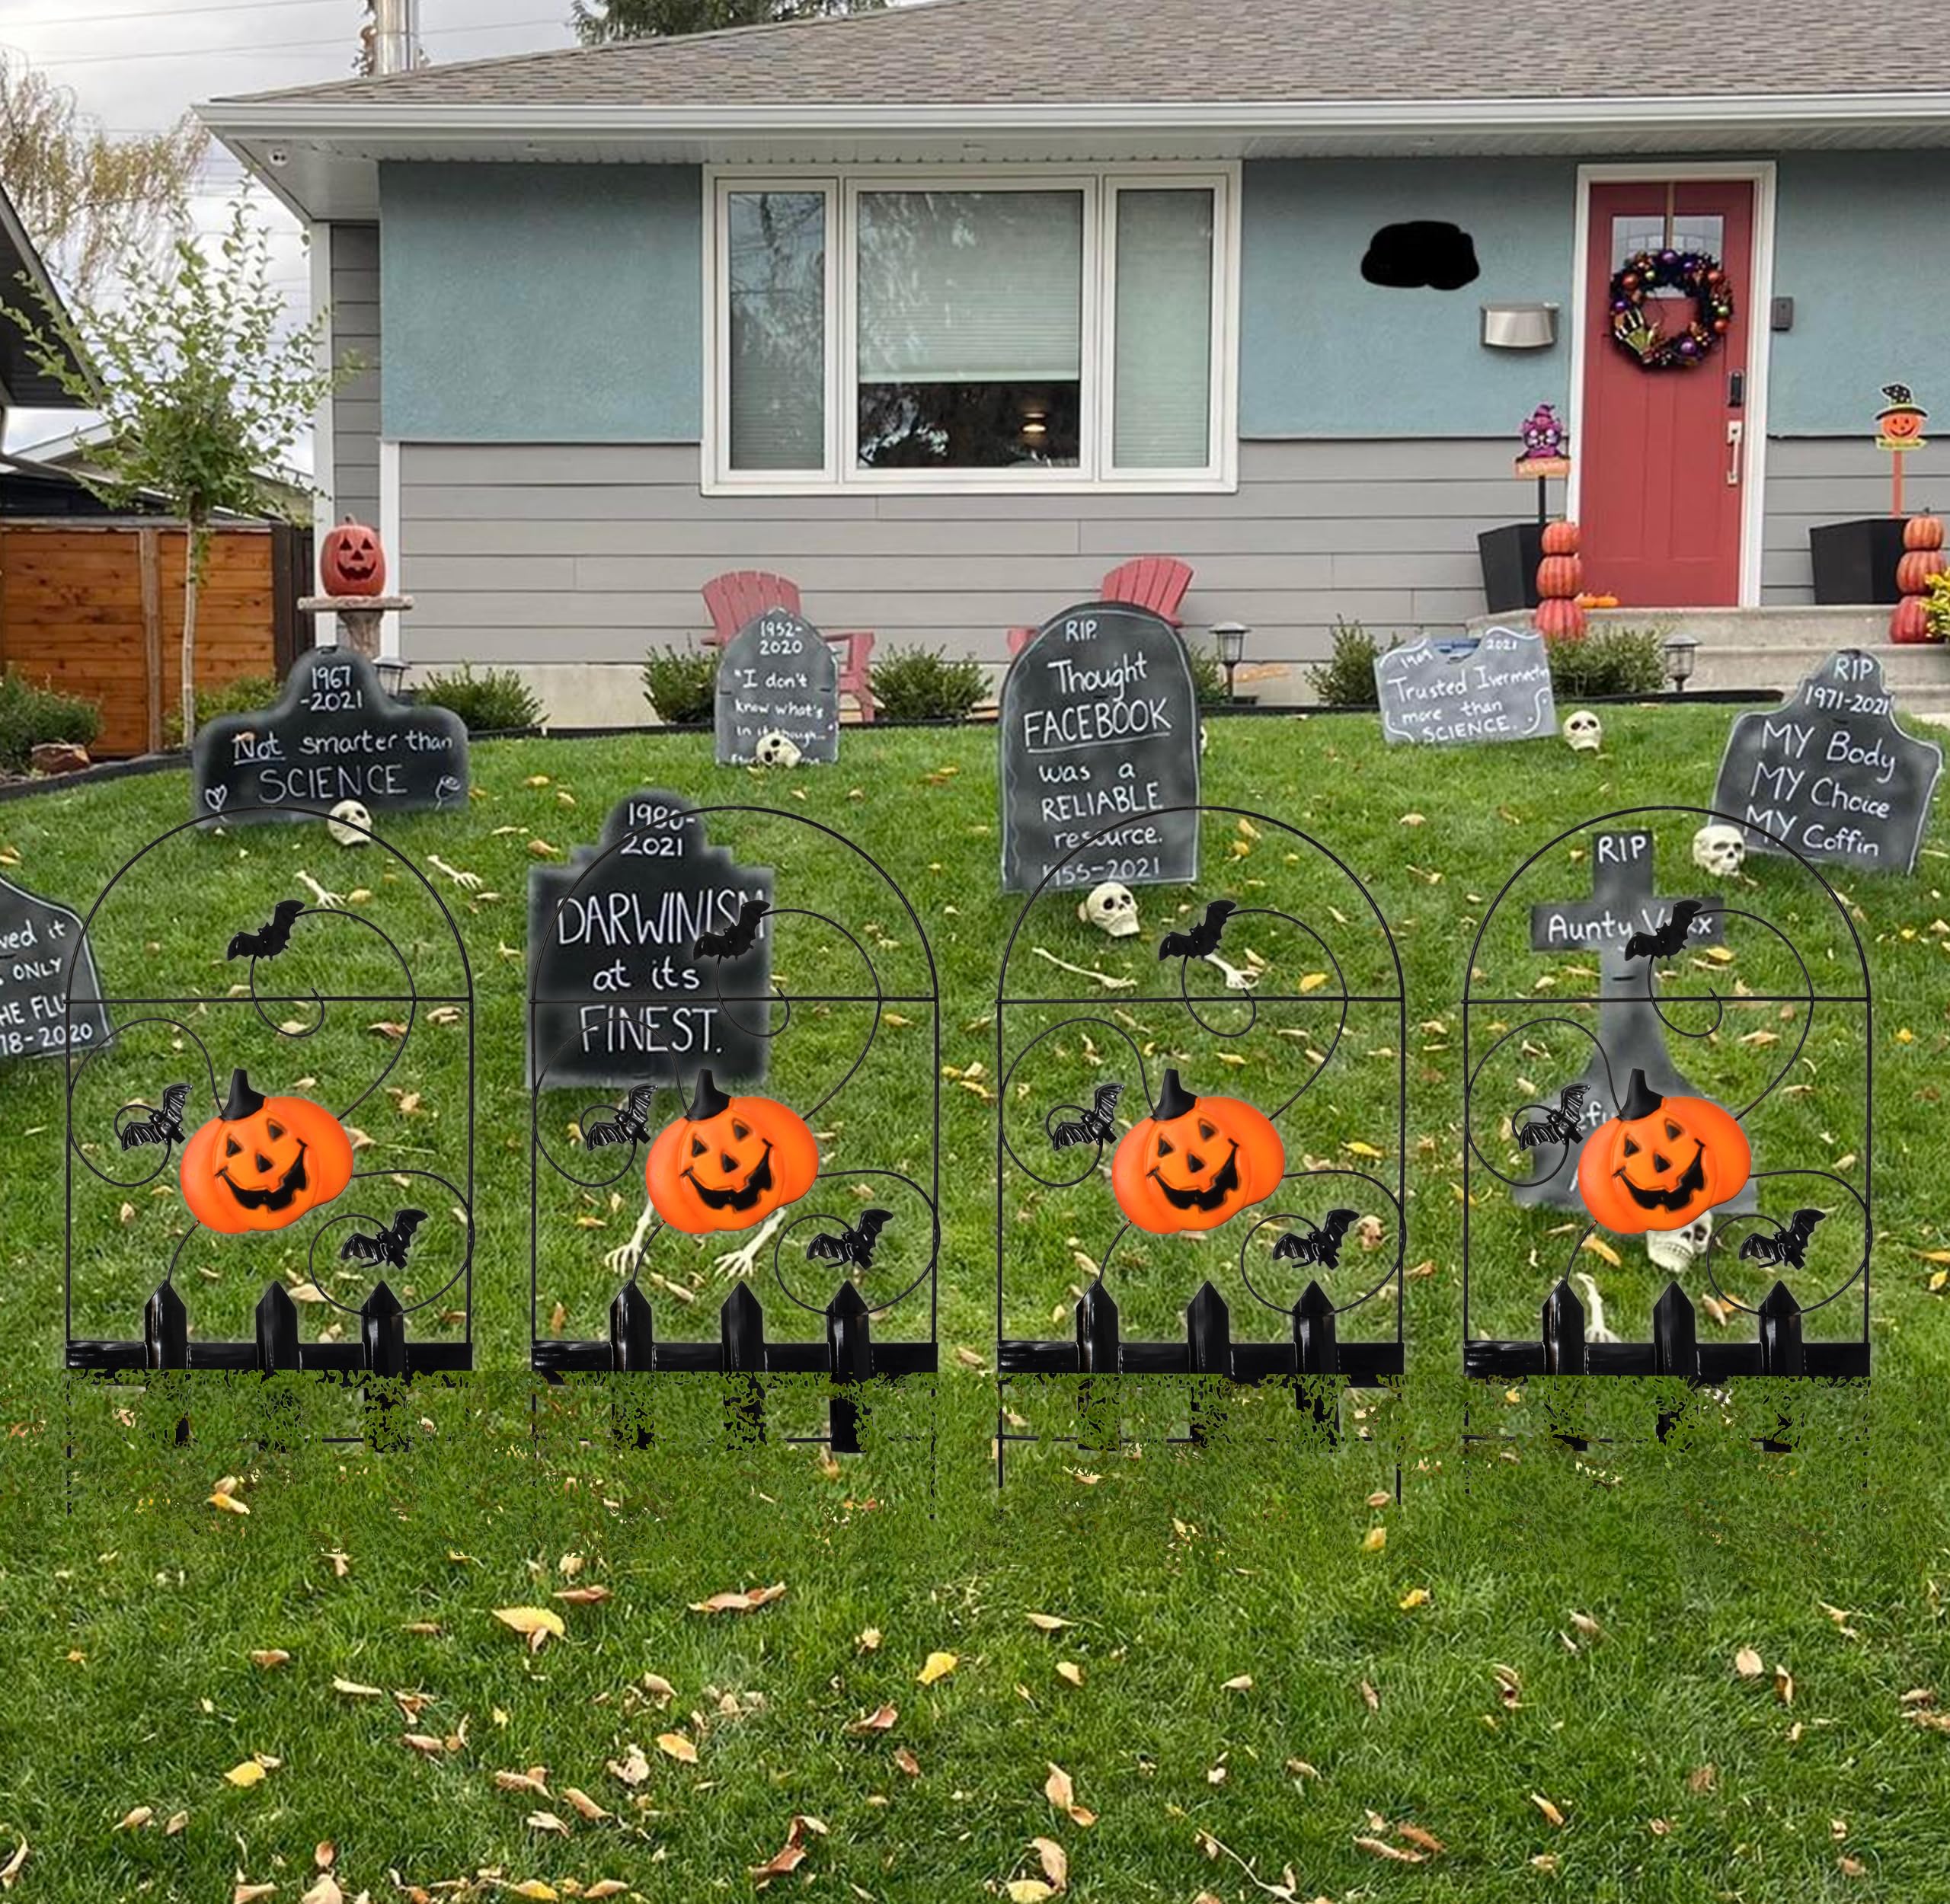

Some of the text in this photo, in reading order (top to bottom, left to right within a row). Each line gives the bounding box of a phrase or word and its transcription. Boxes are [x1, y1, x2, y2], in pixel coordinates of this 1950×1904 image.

[759, 641, 803, 655] 2020
[1485, 639, 1517, 650] 2021
[312, 666, 351, 690] 1967
[765, 672, 808, 688] don't
[1047, 651, 1148, 702] Thought
[1834, 657, 1873, 682] RIP
[1386, 669, 1468, 702] Trusted
[300, 692, 363, 712] -2021
[735, 698, 824, 720] know what's
[1402, 701, 1502, 724] more than
[1805, 685, 1889, 716] 1971-2021
[1023, 698, 1172, 748] FACEBOOK
[233, 730, 453, 762] Not smarter than
[1762, 719, 1895, 784] MY Body
[258, 765, 408, 804] SCIENCE
[1038, 762, 1136, 784] was a
[1041, 781, 1164, 823] RELIABLE
[1750, 762, 1891, 819] MY Choice
[1744, 803, 1879, 857] MY Coffin
[621, 832, 682, 857] 2021
[1598, 835, 1648, 863] RIP
[47, 919, 66, 939] it
[1548, 910, 1633, 952] Aunty
[13, 957, 62, 981] ONLY
[592, 956, 701, 991] at its
[30, 992, 67, 1021] FLU
